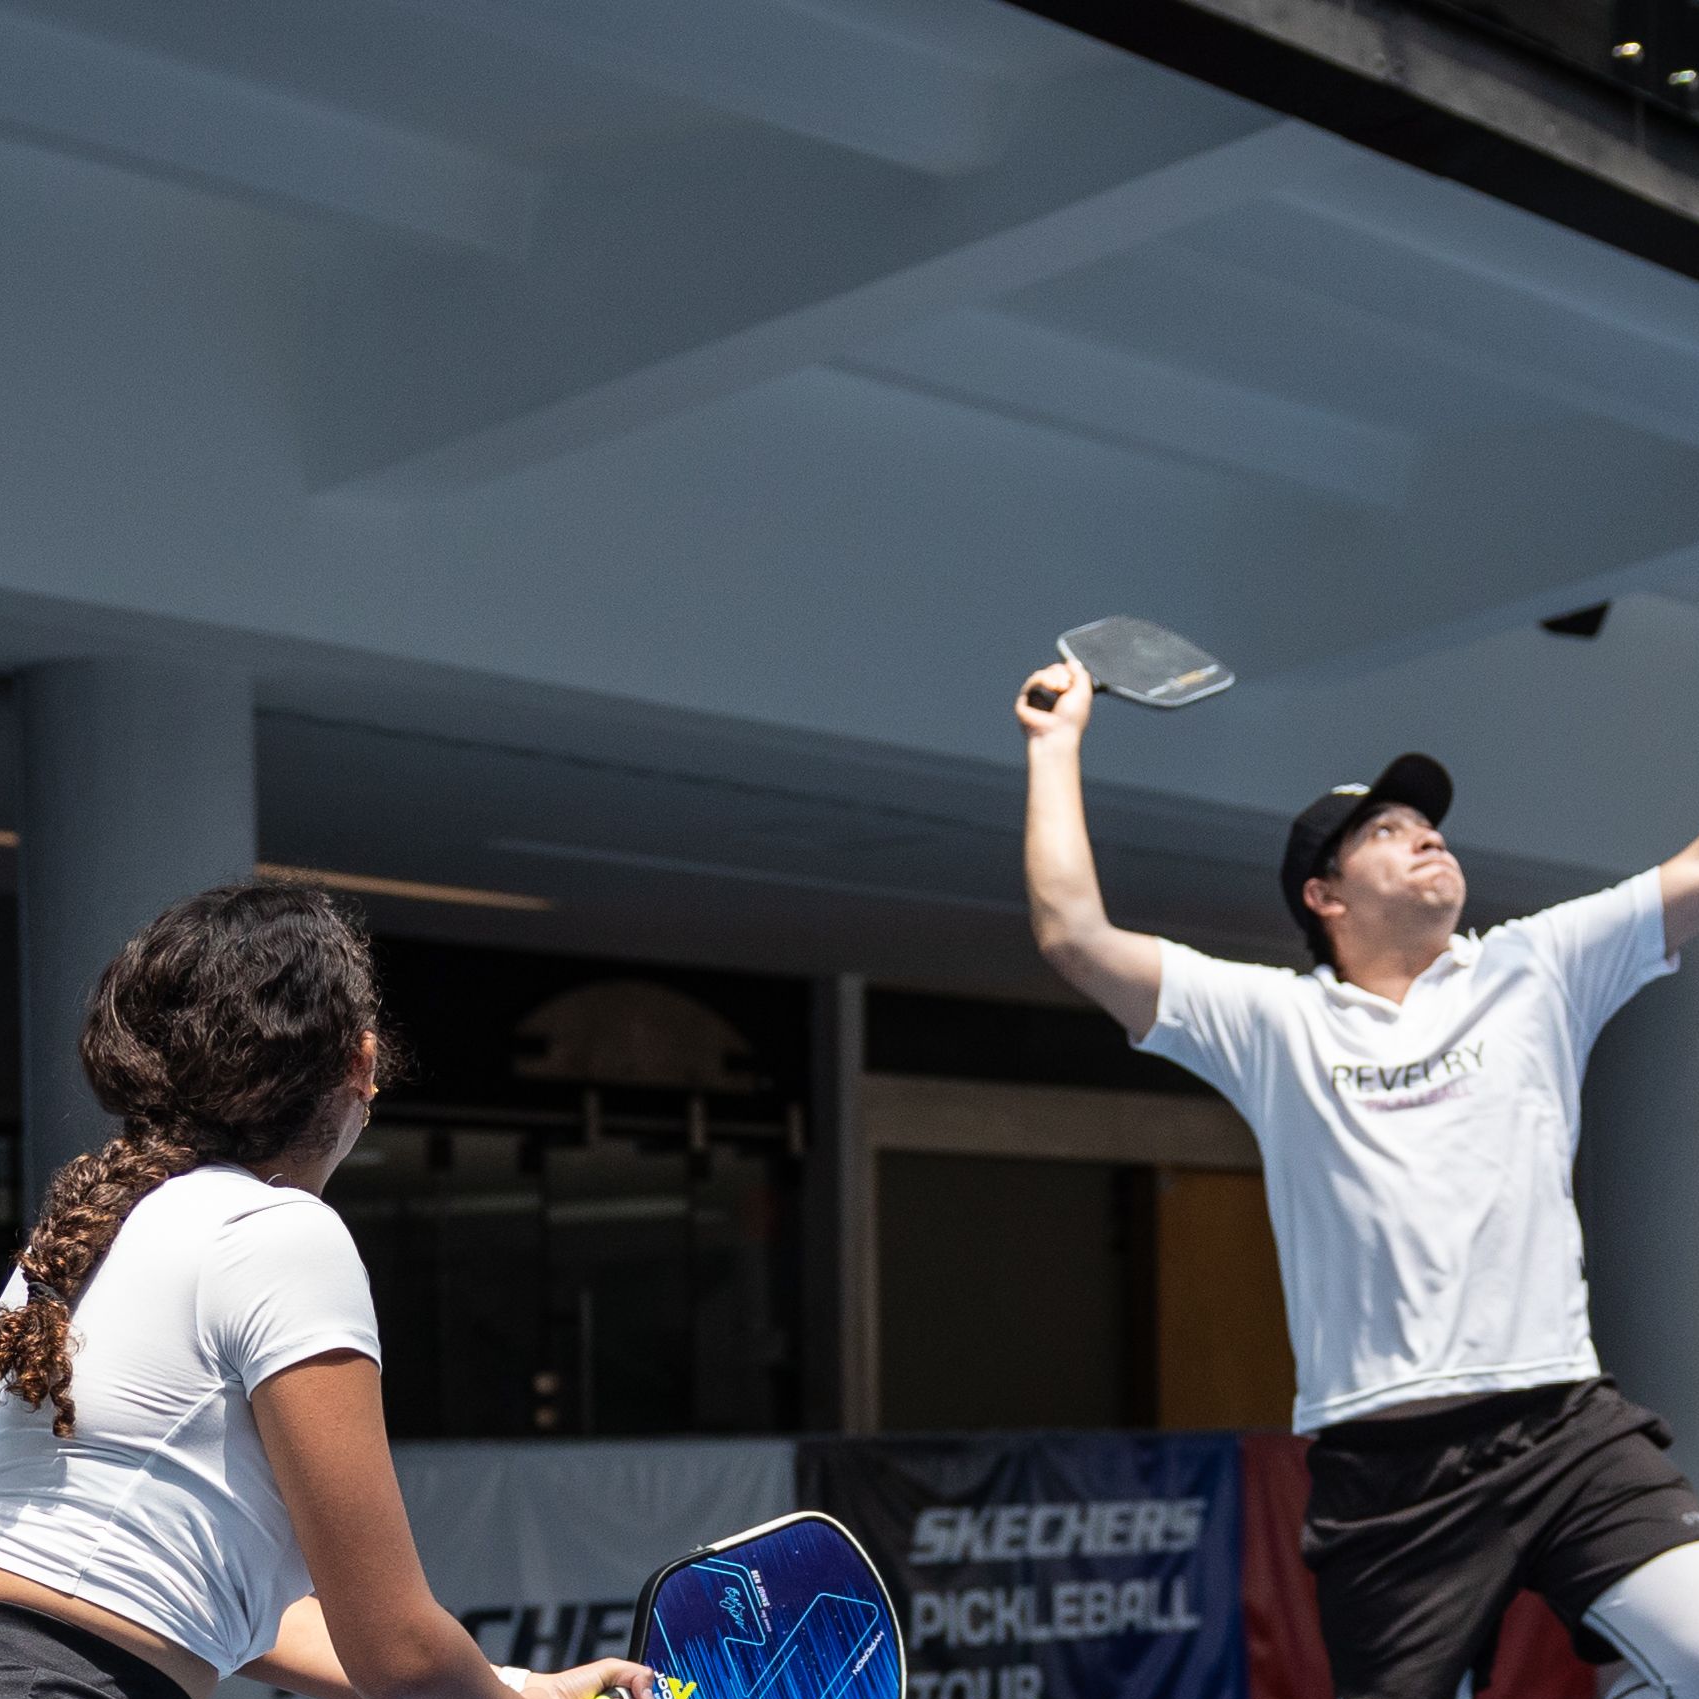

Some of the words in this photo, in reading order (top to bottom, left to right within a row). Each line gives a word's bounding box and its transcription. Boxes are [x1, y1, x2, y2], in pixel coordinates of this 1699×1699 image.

[1331, 1040, 1485, 1092] REVELRY
[909, 1498, 1206, 1565] SKECHERS
[910, 1576, 1201, 1649] PICKLEBALL
